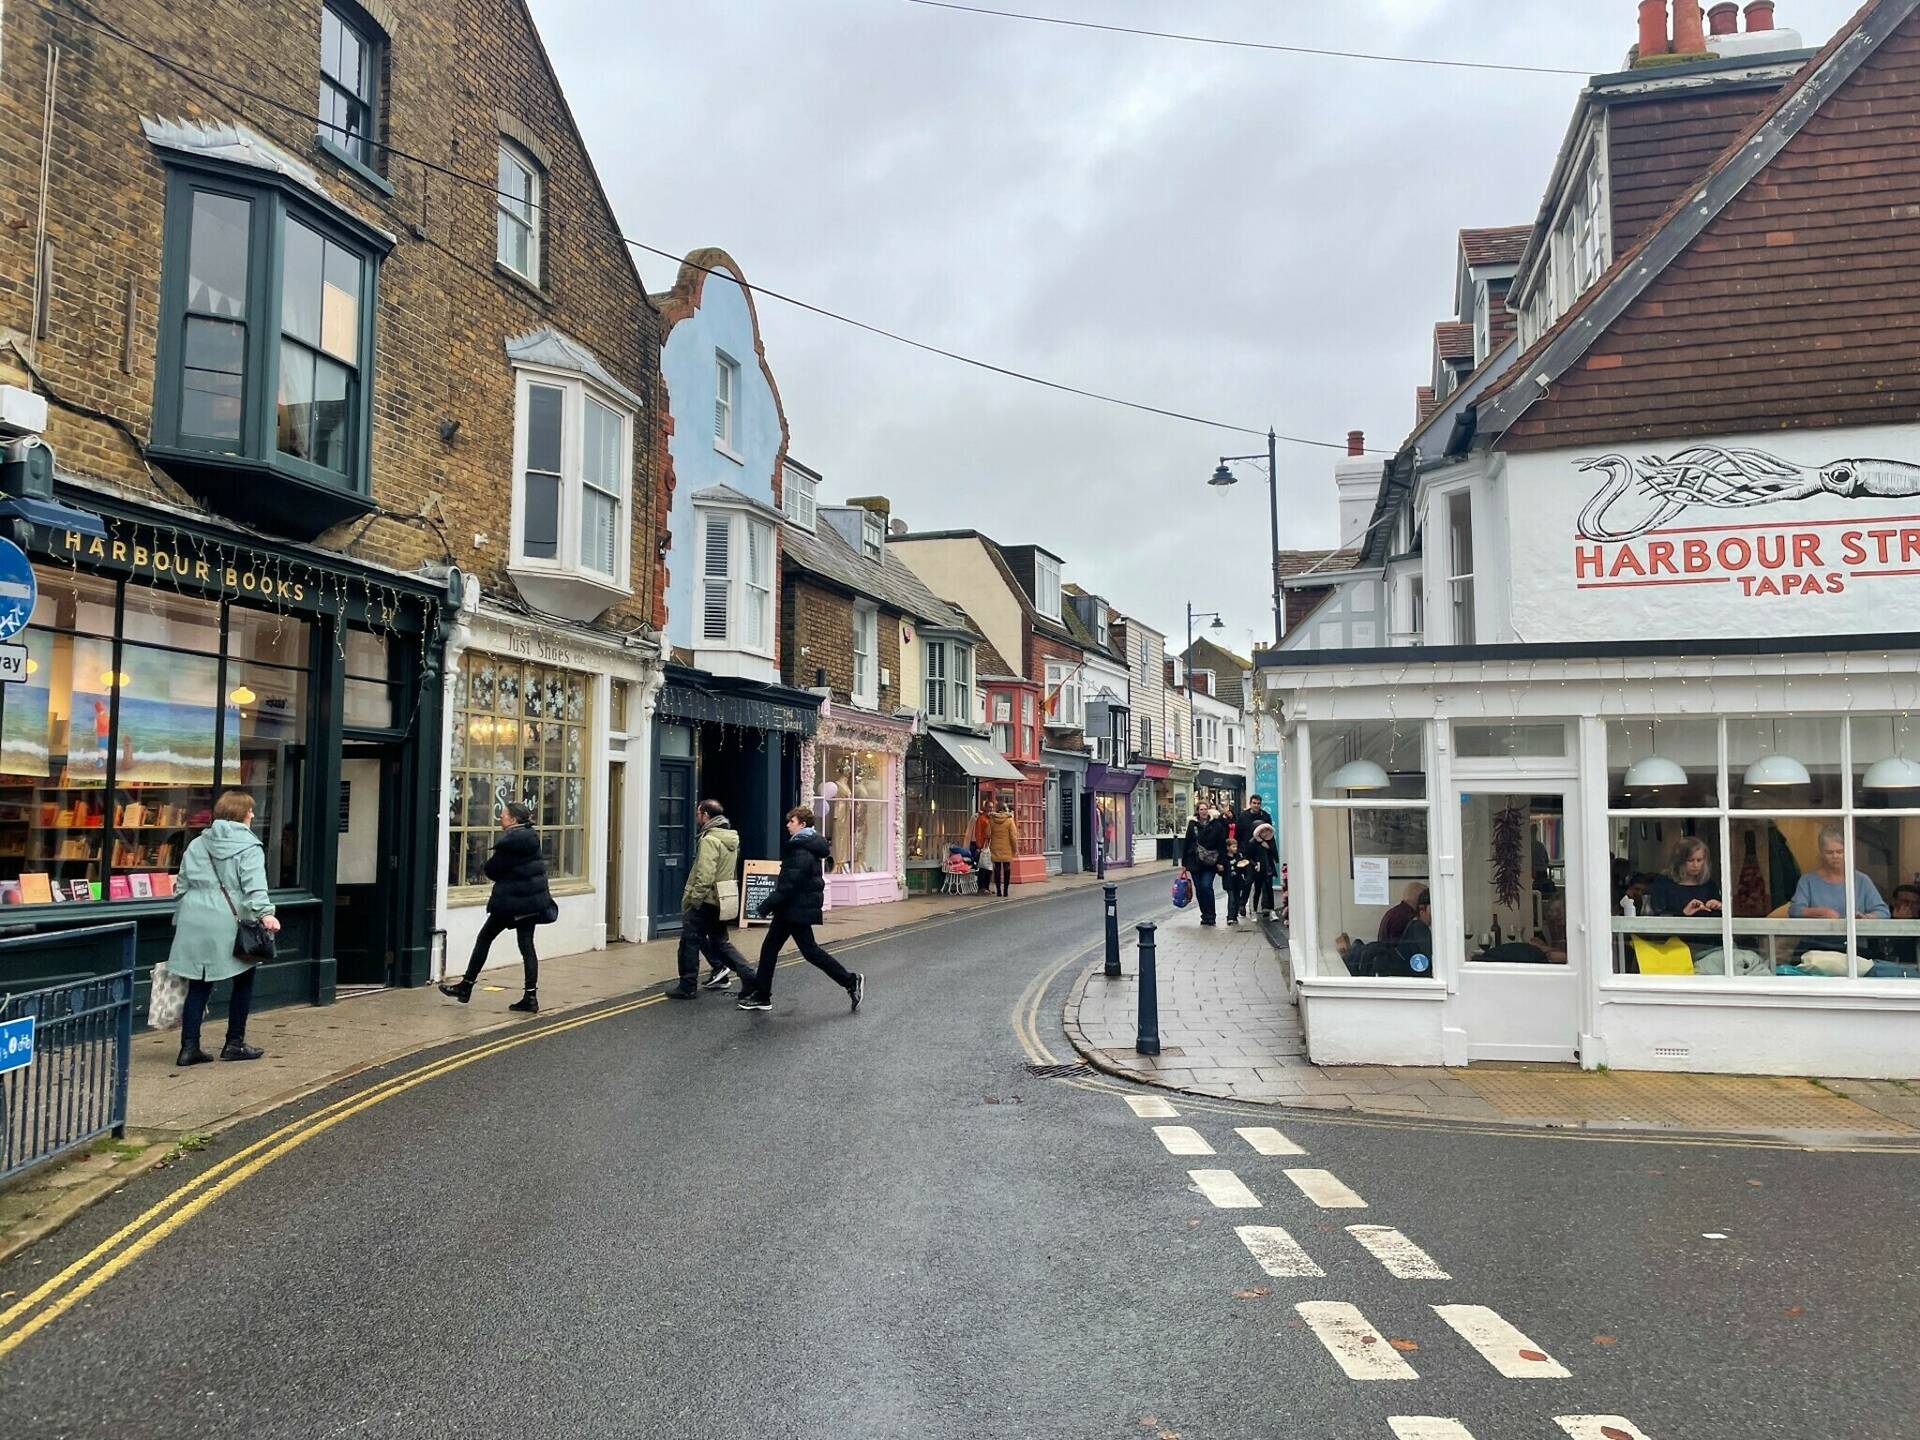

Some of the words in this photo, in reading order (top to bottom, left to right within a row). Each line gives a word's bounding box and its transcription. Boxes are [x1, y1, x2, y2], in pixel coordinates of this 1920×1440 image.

[65, 530, 210, 582] HARBOUR
[225, 567, 304, 601] BOOKS
[1575, 534, 1825, 579] HARBOUR
[1841, 529, 1920, 565] STR
[1737, 573, 1845, 597] TAPAS
[508, 633, 530, 655] Just
[537, 640, 570, 664] Shoes
[0, 656, 21, 673] ay
